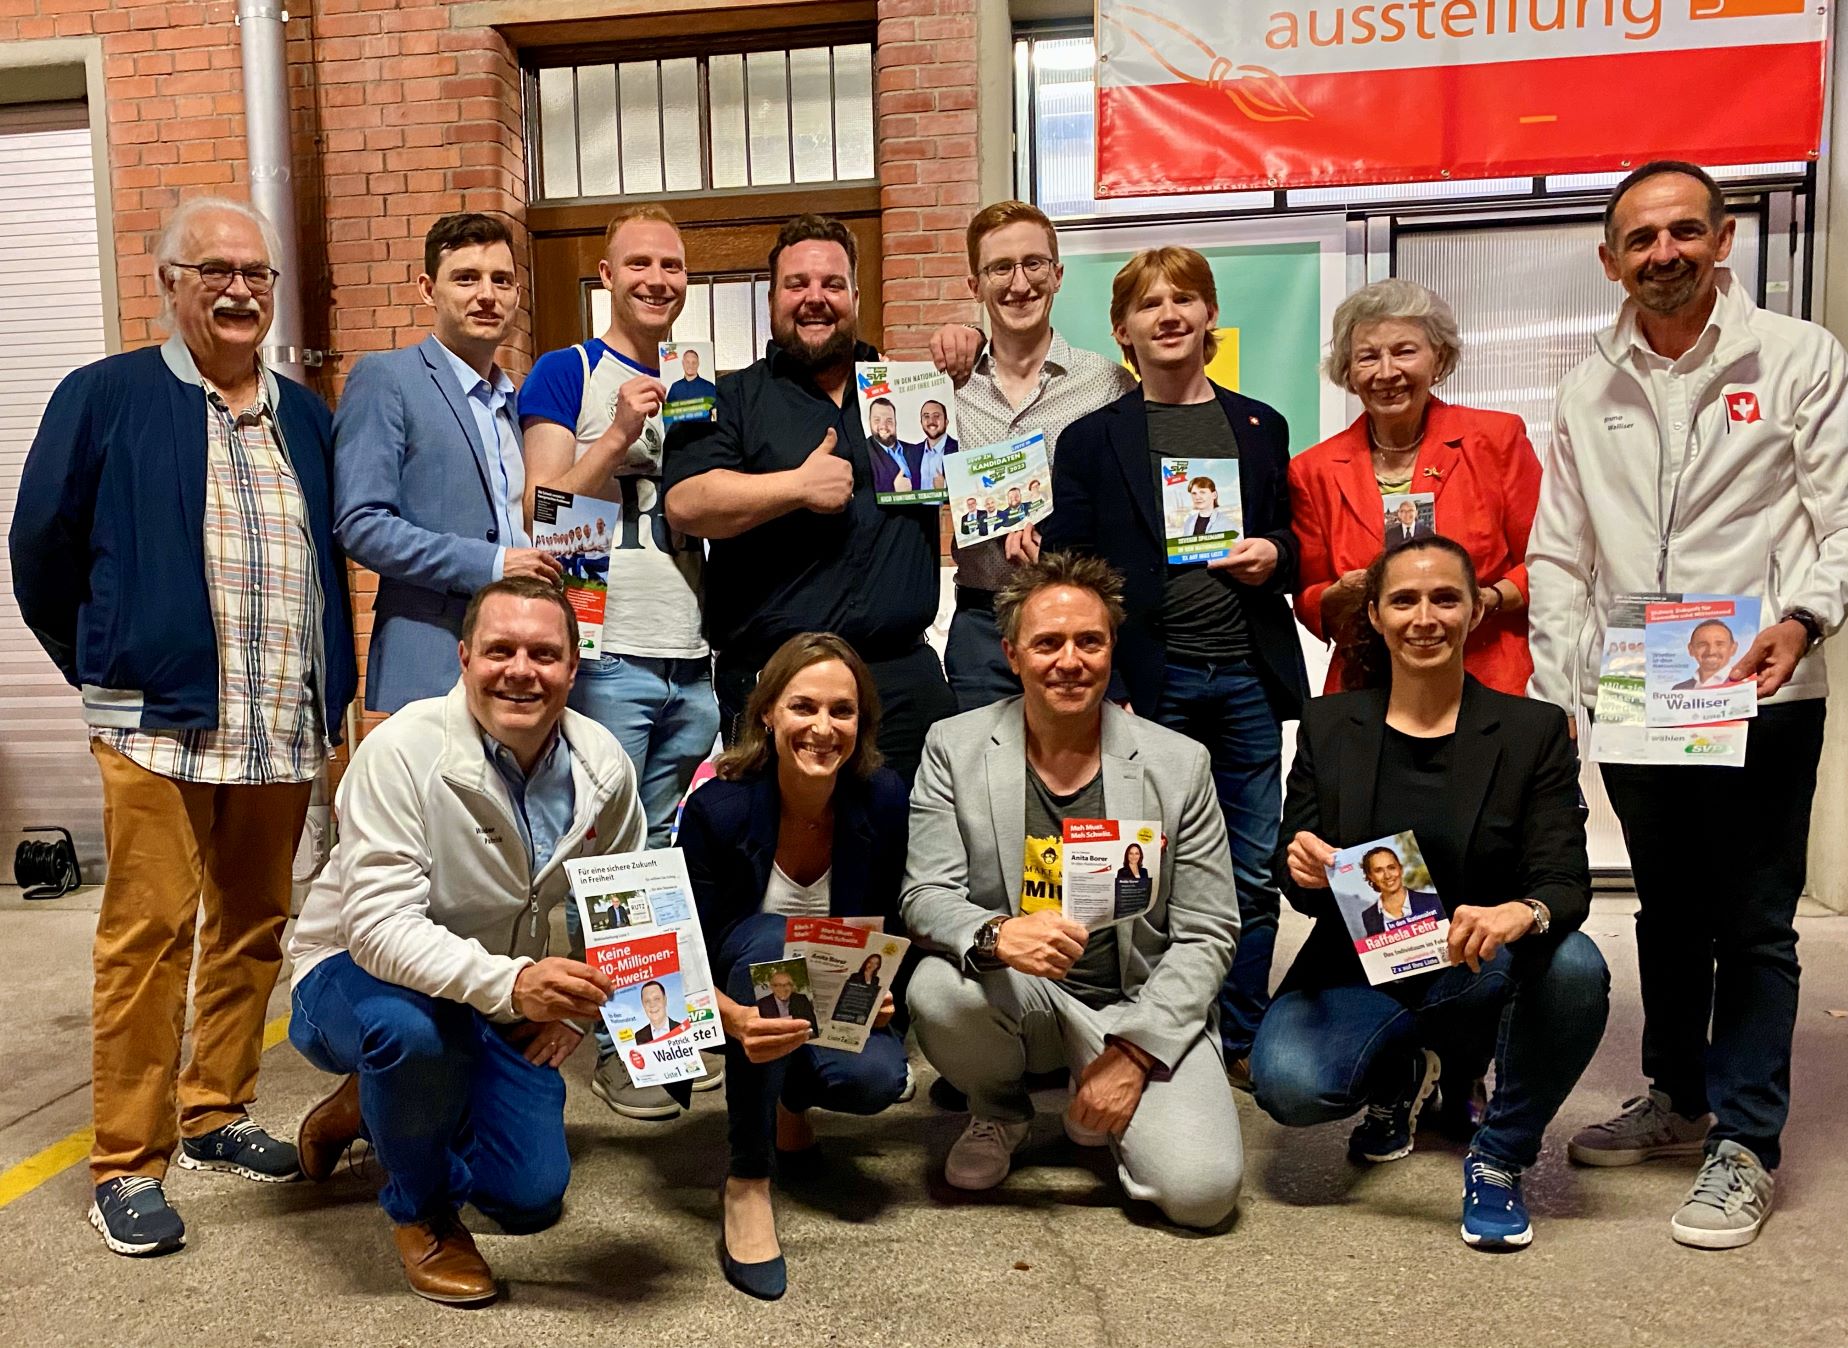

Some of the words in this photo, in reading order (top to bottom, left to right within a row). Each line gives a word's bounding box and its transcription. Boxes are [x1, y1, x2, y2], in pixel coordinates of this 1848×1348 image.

[972, 452, 1021, 471] KANDIDATEN
[1009, 464, 1025, 472] 2023
[1652, 692, 1684, 700] Bruno
[1666, 697, 1730, 710] Walliser
[578, 867, 590, 875] Für
[591, 865, 606, 874] eine
[606, 863, 631, 873] sichere
[631, 860, 658, 870] Zukunft
[588, 874, 615, 884] Freiheit
[1365, 928, 1411, 950] Raffaela
[1411, 920, 1436, 936] Fehr
[597, 946, 631, 963] Keine
[600, 949, 674, 975] 10-Millionen-
[611, 966, 654, 987] hweiz!
[688, 1010, 707, 1021] VP
[667, 1036, 690, 1047] Patrick
[653, 1045, 694, 1063] Walder
